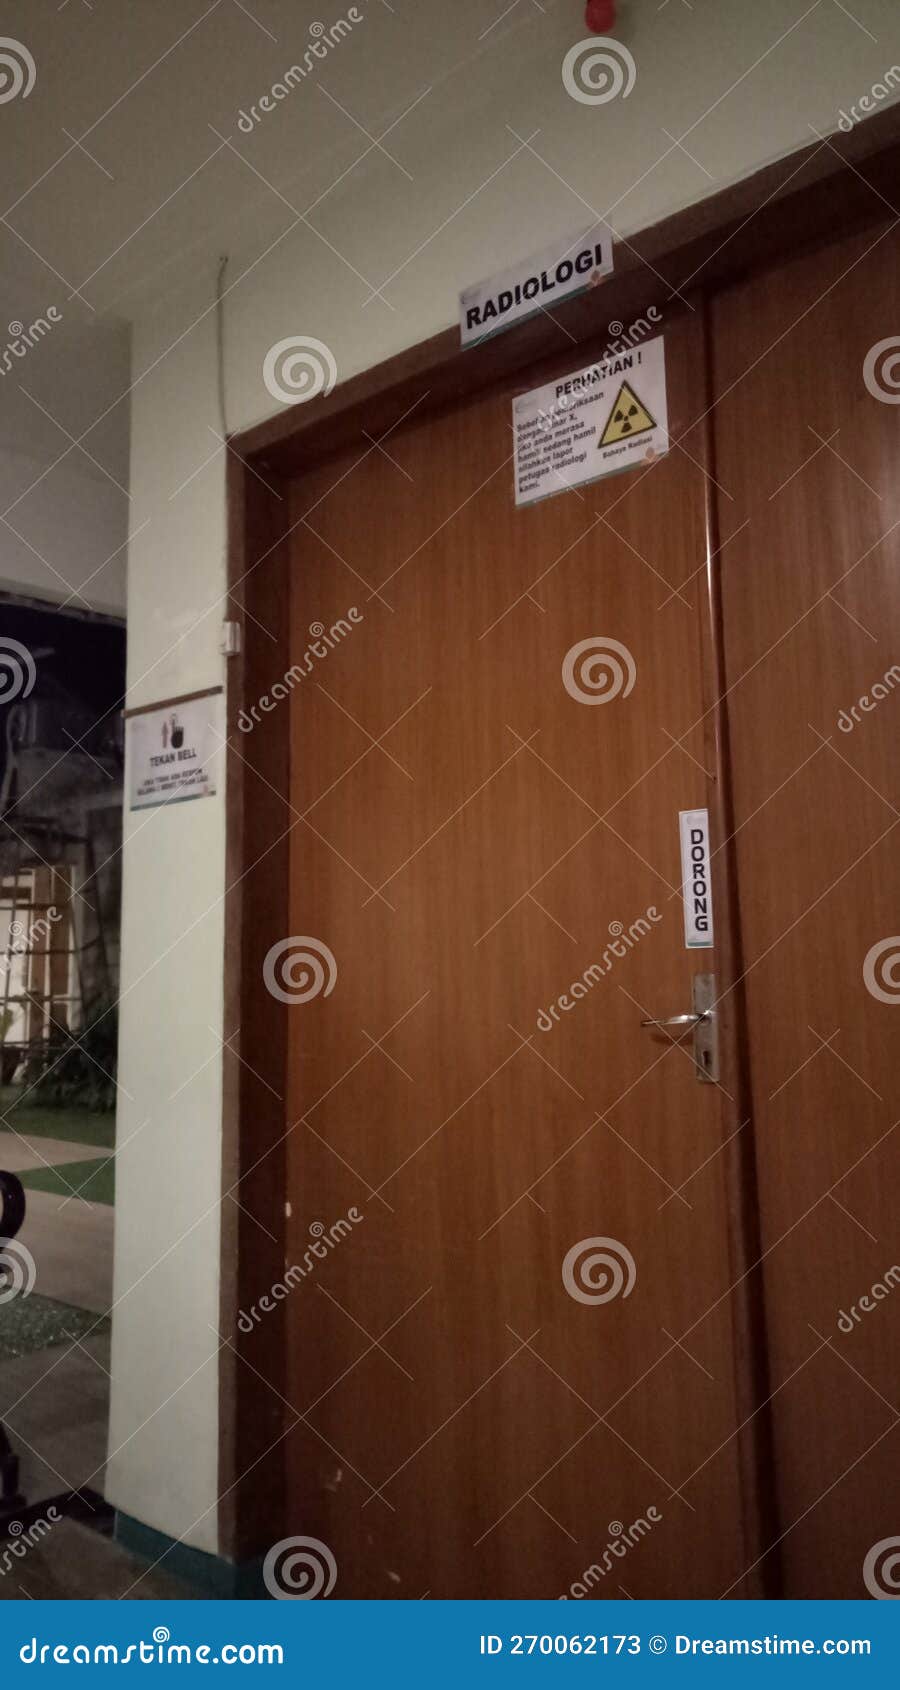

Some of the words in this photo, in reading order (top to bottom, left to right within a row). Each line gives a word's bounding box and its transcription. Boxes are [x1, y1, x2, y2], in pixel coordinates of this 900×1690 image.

[466, 244, 602, 329] RADIOLOGI
[556, 355, 633, 398] PERHATIAN
[555, 421, 584, 437] merasa
[574, 426, 596, 440] hamil
[553, 447, 573, 460] lapor
[690, 829, 709, 932] DORONG
